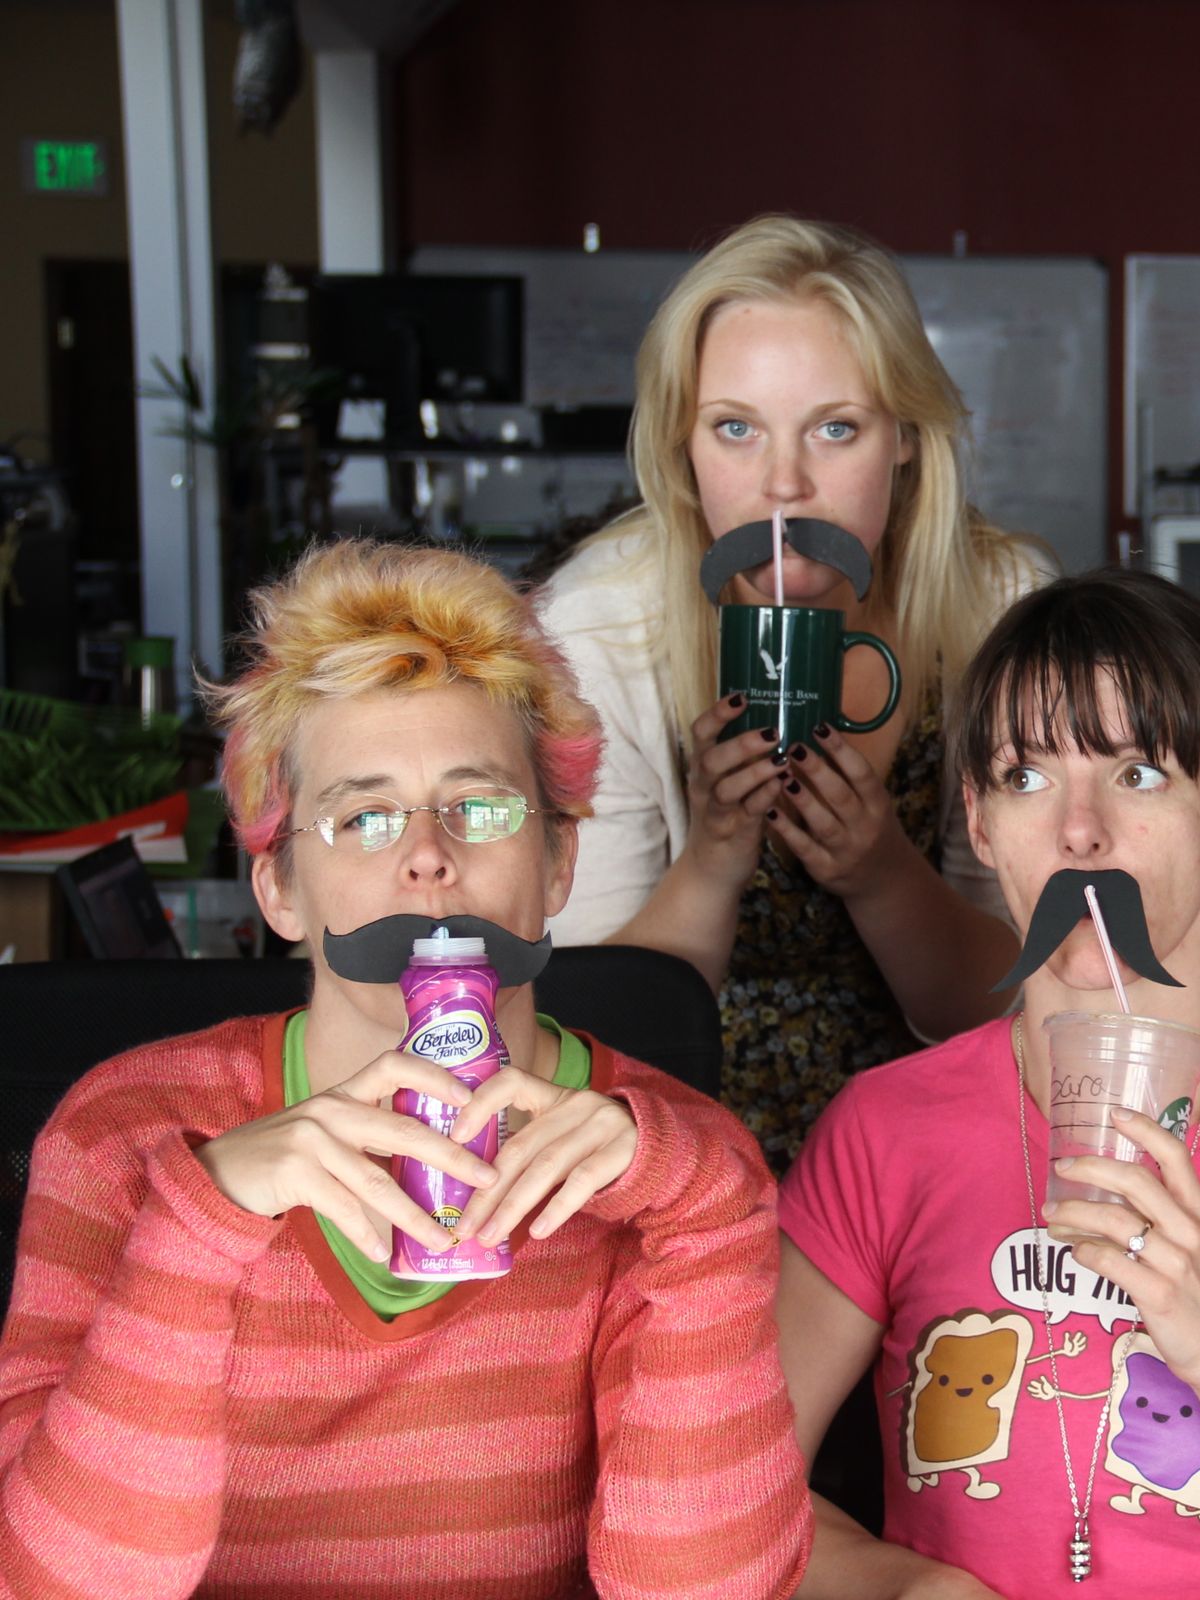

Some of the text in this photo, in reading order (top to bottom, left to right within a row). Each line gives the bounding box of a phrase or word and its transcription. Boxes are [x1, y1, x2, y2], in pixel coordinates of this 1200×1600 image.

[36, 143, 97, 190] EXIT
[750, 688, 794, 699] REPUBIC
[420, 1027, 476, 1051] Berkeley
[434, 1046, 469, 1061] Farms
[1009, 1243, 1076, 1296] HUG
